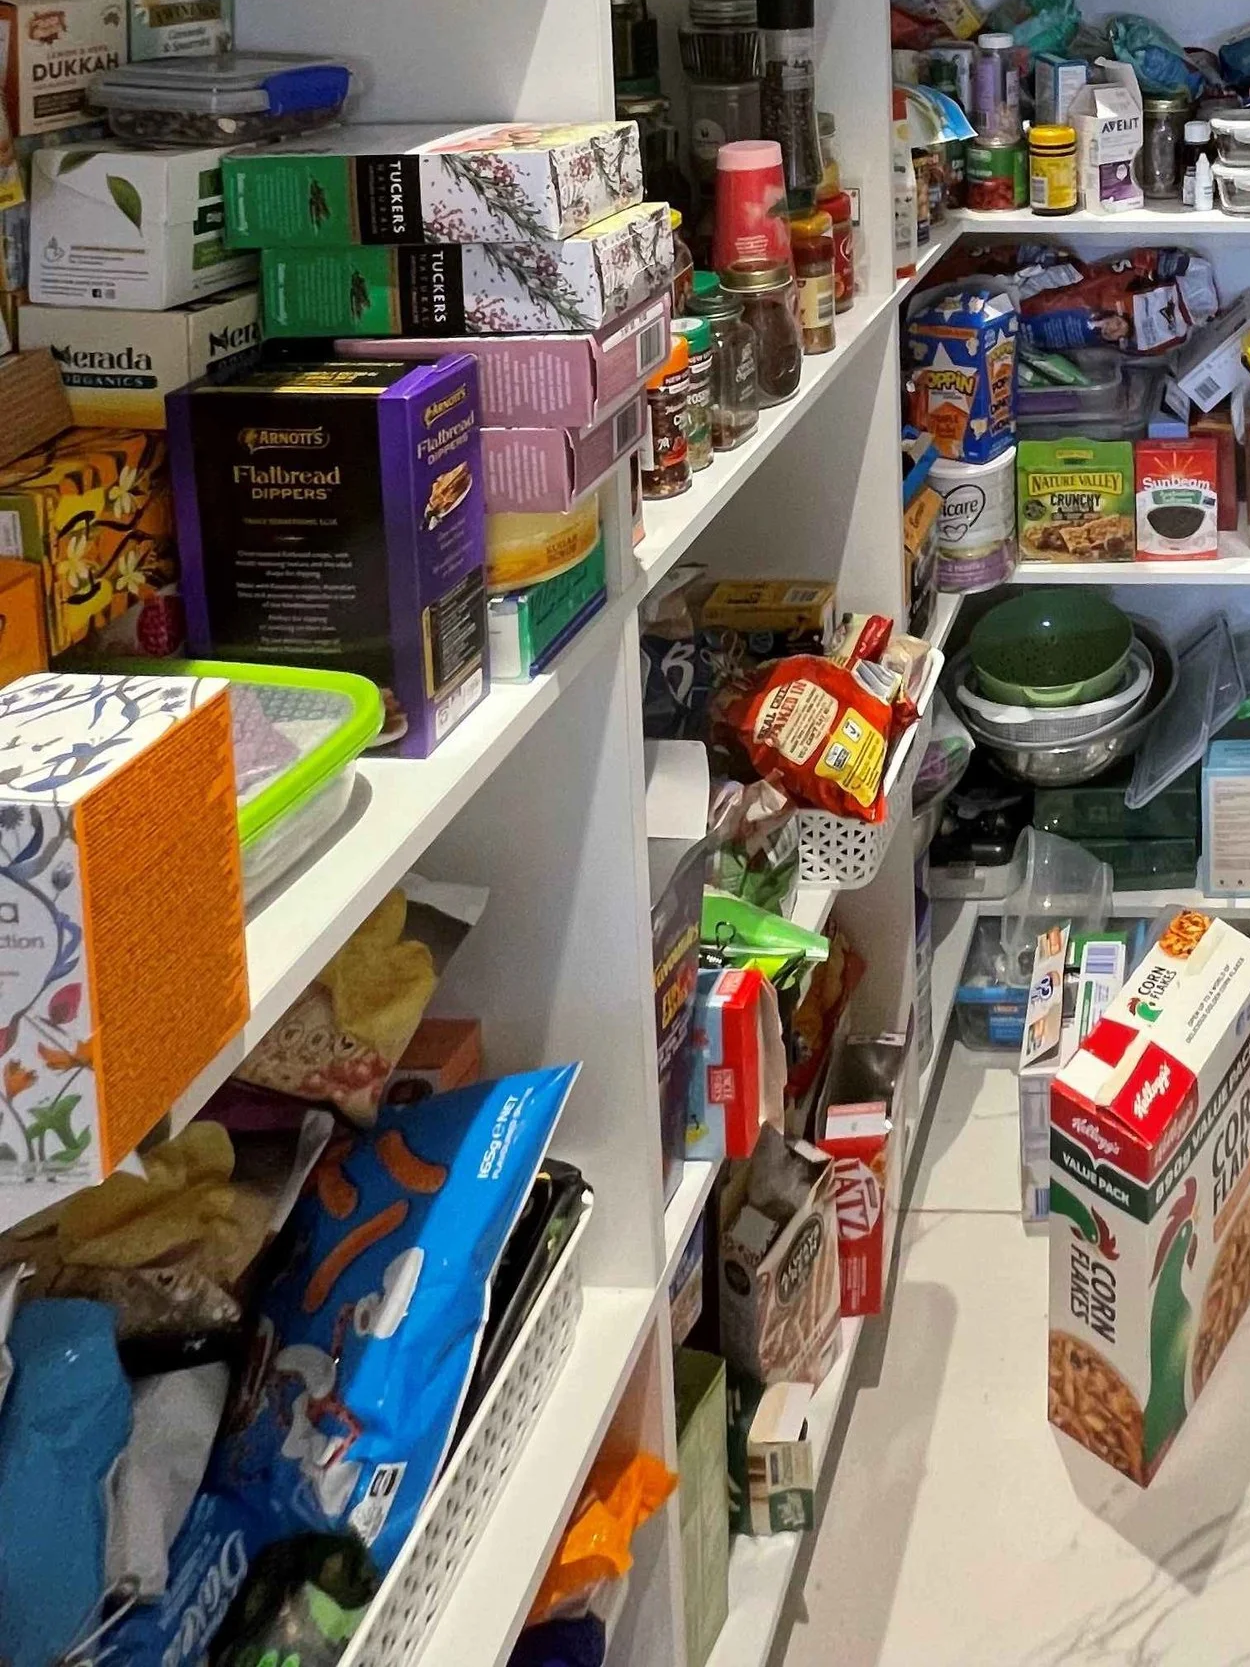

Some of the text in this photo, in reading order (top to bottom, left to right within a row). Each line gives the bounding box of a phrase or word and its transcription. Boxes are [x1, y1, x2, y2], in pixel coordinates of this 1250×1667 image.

[32, 51, 120, 82] DUKKAH
[208, 323, 261, 352] Ner
[50, 343, 153, 372] Nerada
[926, 370, 974, 396] OPPIN
[417, 410, 475, 461] Flatbread
[233, 465, 341, 486] Flatbread
[1031, 473, 1121, 494] NATURE VALLEY
[1142, 475, 1210, 491] Sunbeam
[251, 488, 328, 501] DIPPERS
[942, 496, 979, 518] icare
[1050, 493, 1101, 507] CRUNCHY
[1137, 965, 1167, 996] CORN
[1150, 969, 1177, 1001] FLAKES
[1133, 1059, 1171, 1121] Kellogg's
[1071, 1117, 1122, 1156] Kellogg's
[1062, 1151, 1131, 1206] VALUE PACK
[1069, 1242, 1089, 1330] FLAKES
[1088, 1260, 1117, 1345] CORN
